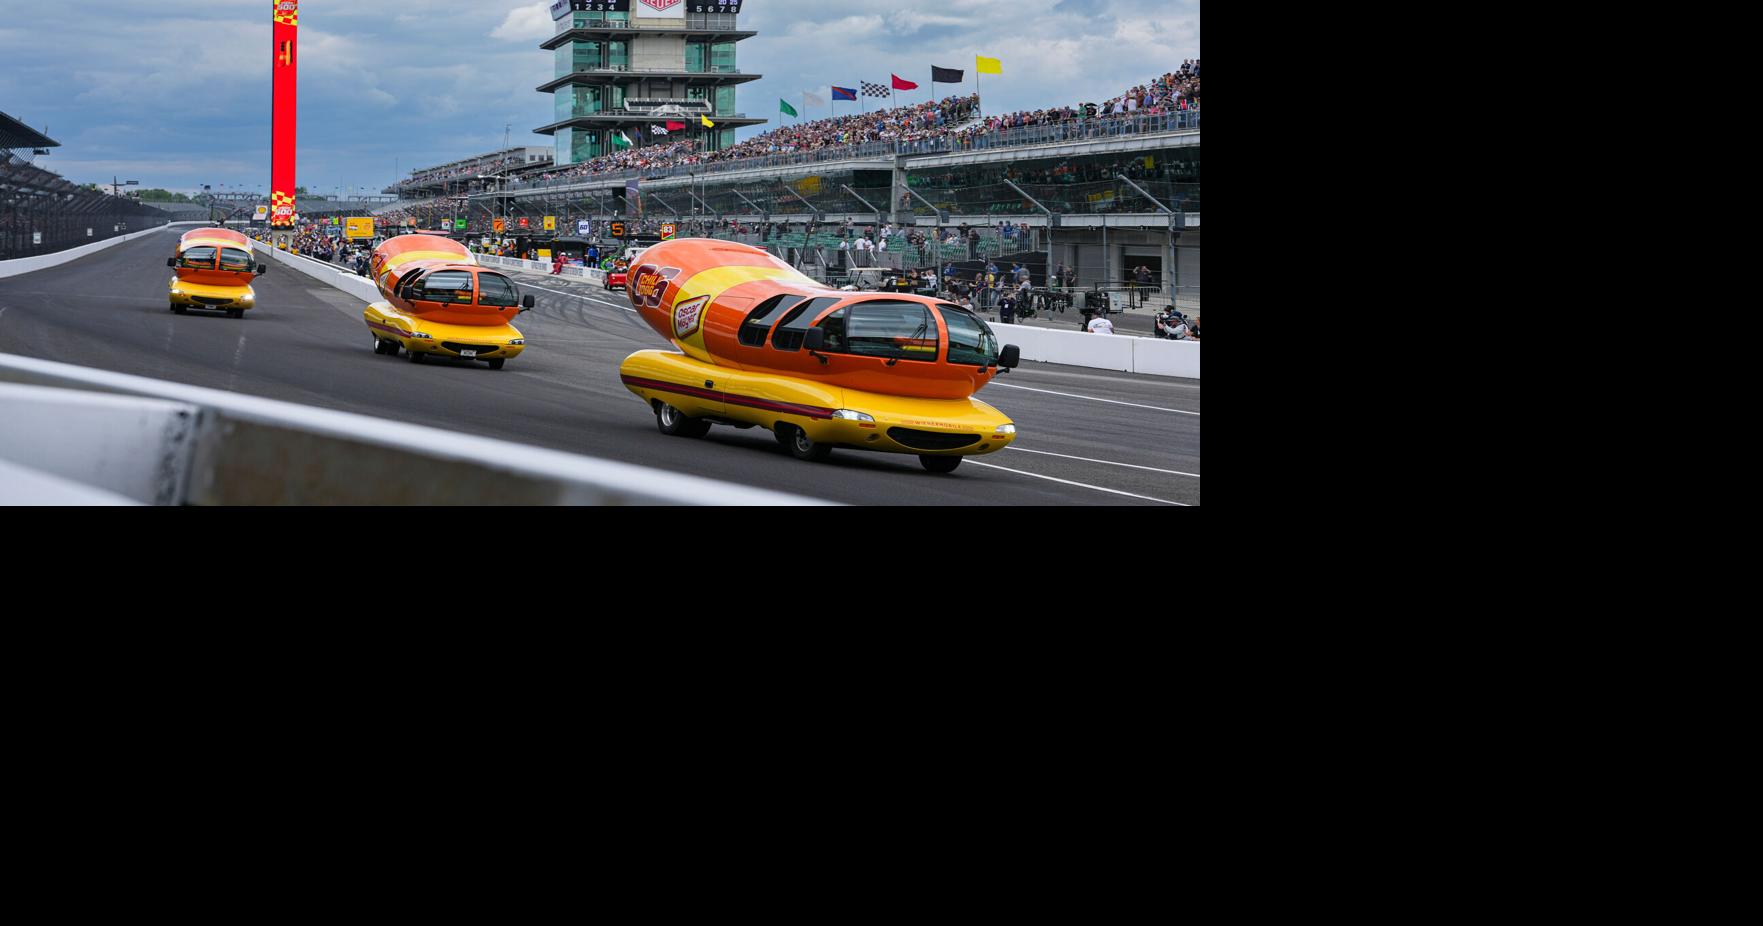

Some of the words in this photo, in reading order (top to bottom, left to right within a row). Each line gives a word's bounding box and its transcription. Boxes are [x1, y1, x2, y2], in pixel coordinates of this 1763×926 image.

[611, 223, 624, 236] 5
[678, 303, 701, 318] Oscar
[677, 313, 697, 329] Mayer
